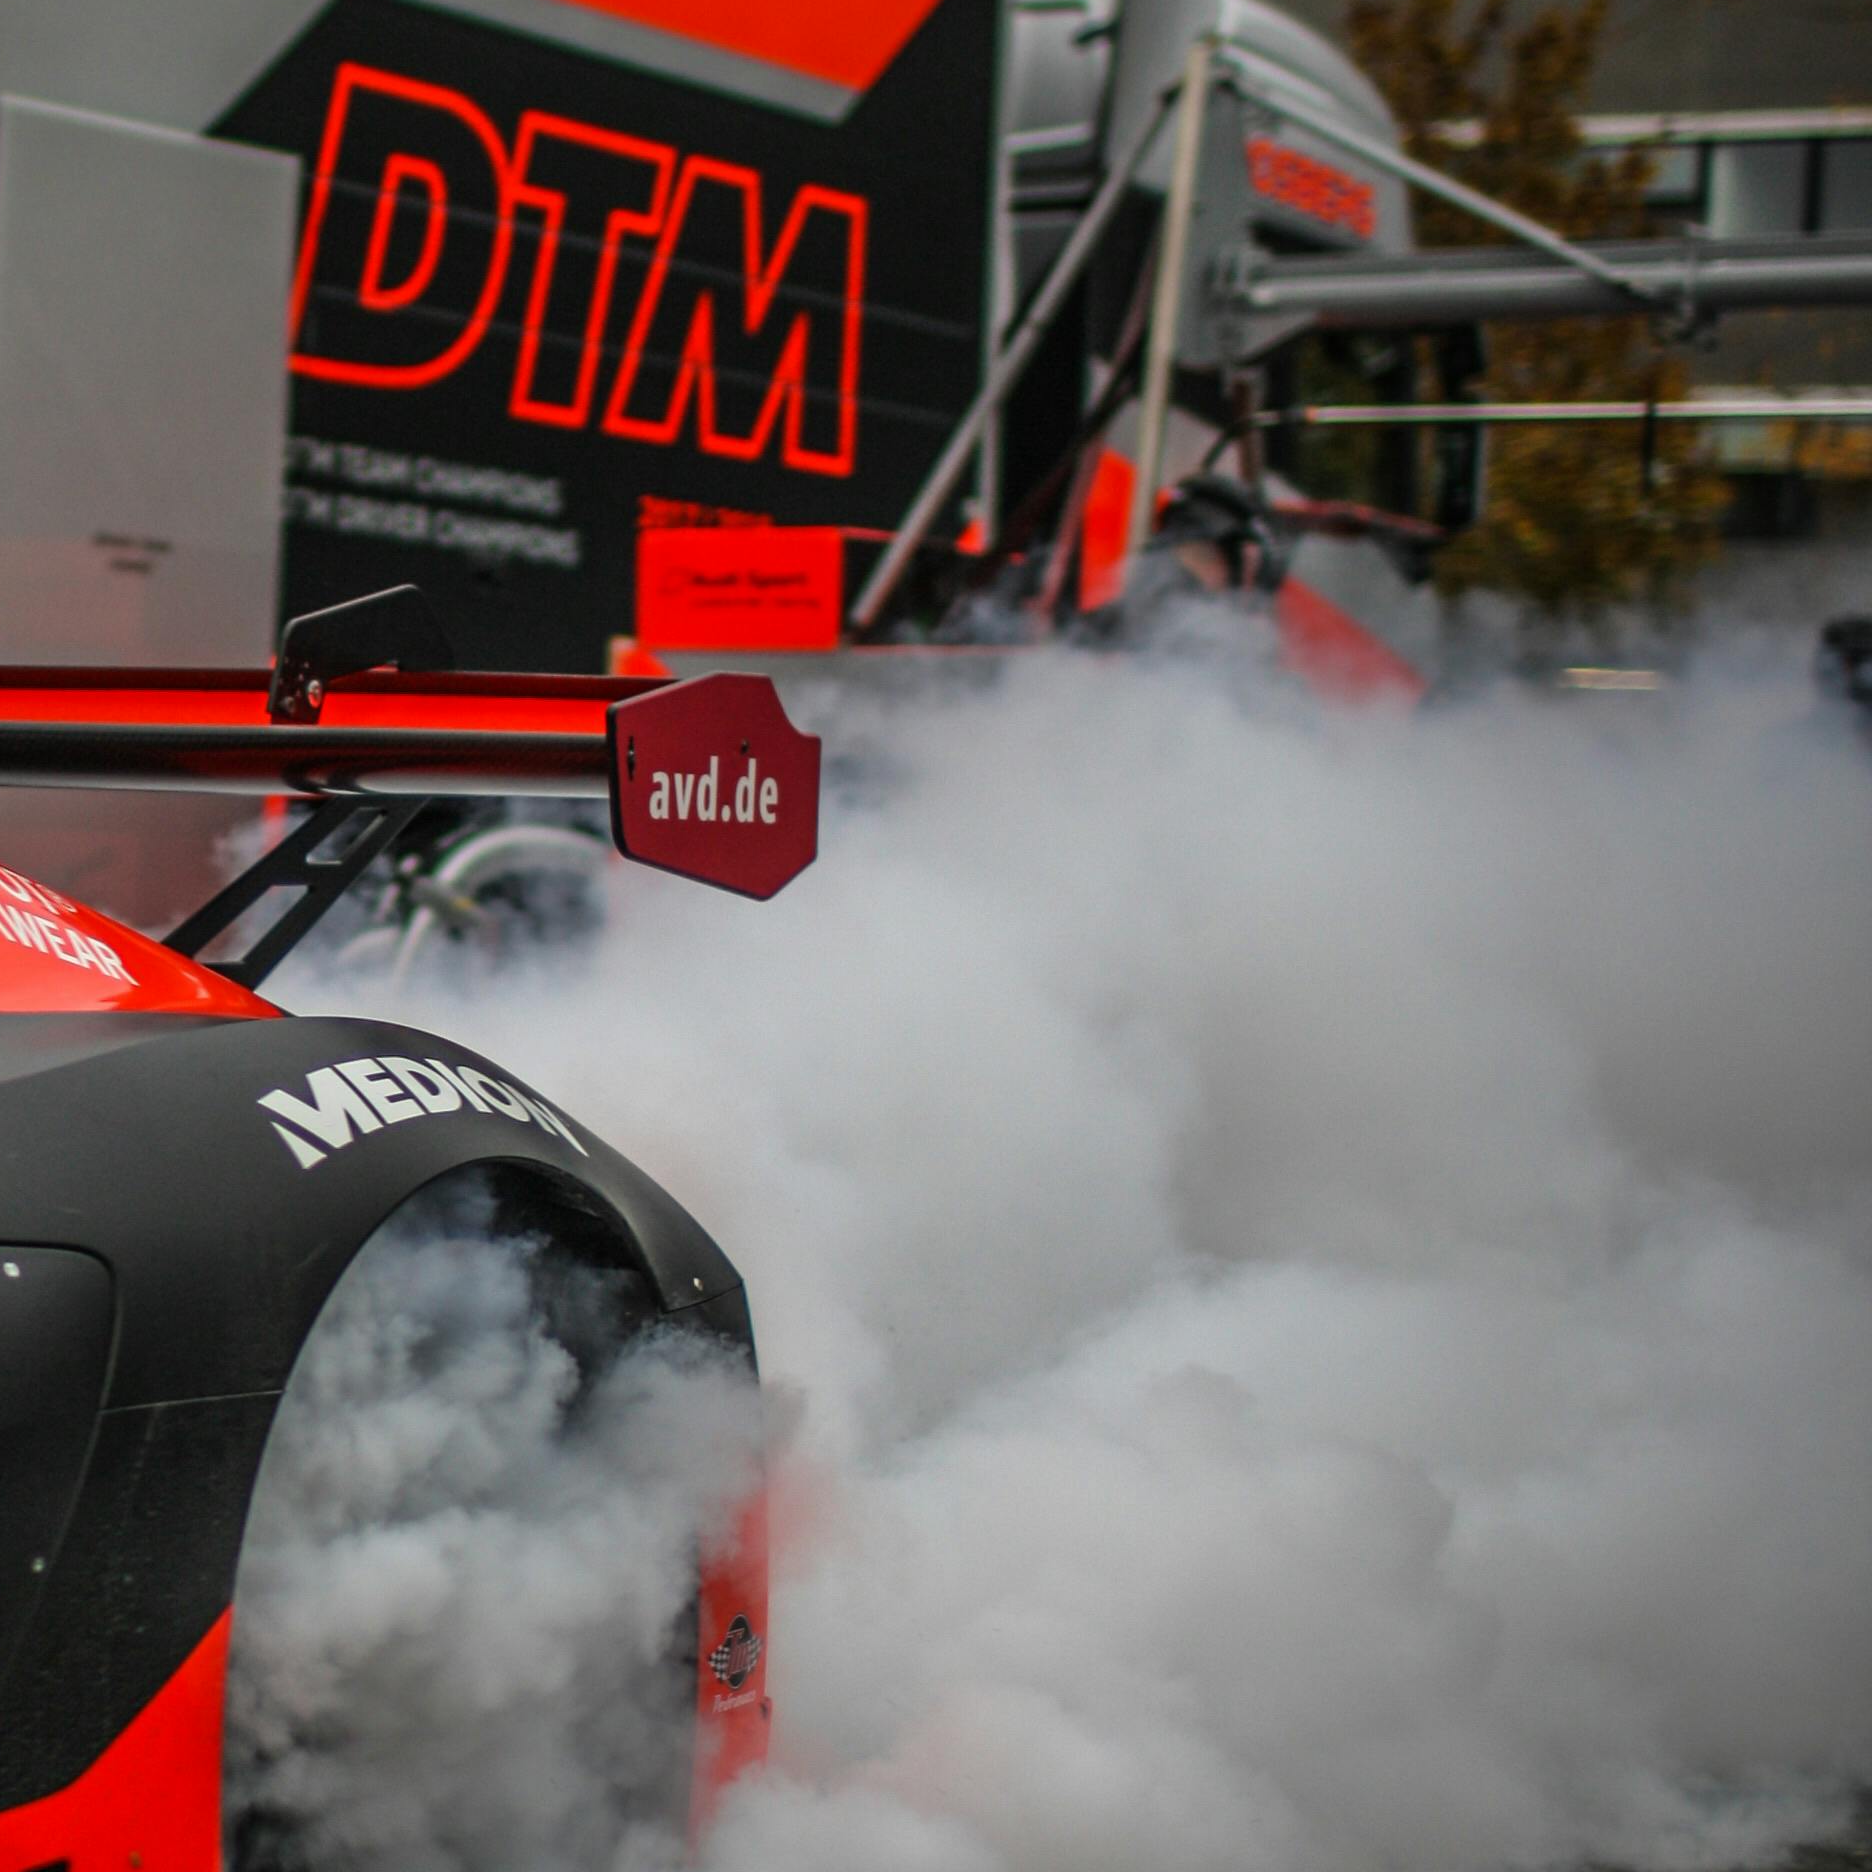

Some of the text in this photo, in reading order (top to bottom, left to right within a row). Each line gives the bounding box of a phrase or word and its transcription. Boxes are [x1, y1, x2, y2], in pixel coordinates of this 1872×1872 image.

[286, 61, 869, 478] DTM
[649, 755, 779, 824] avd.de
[256, 1055, 590, 1170] MEDION
